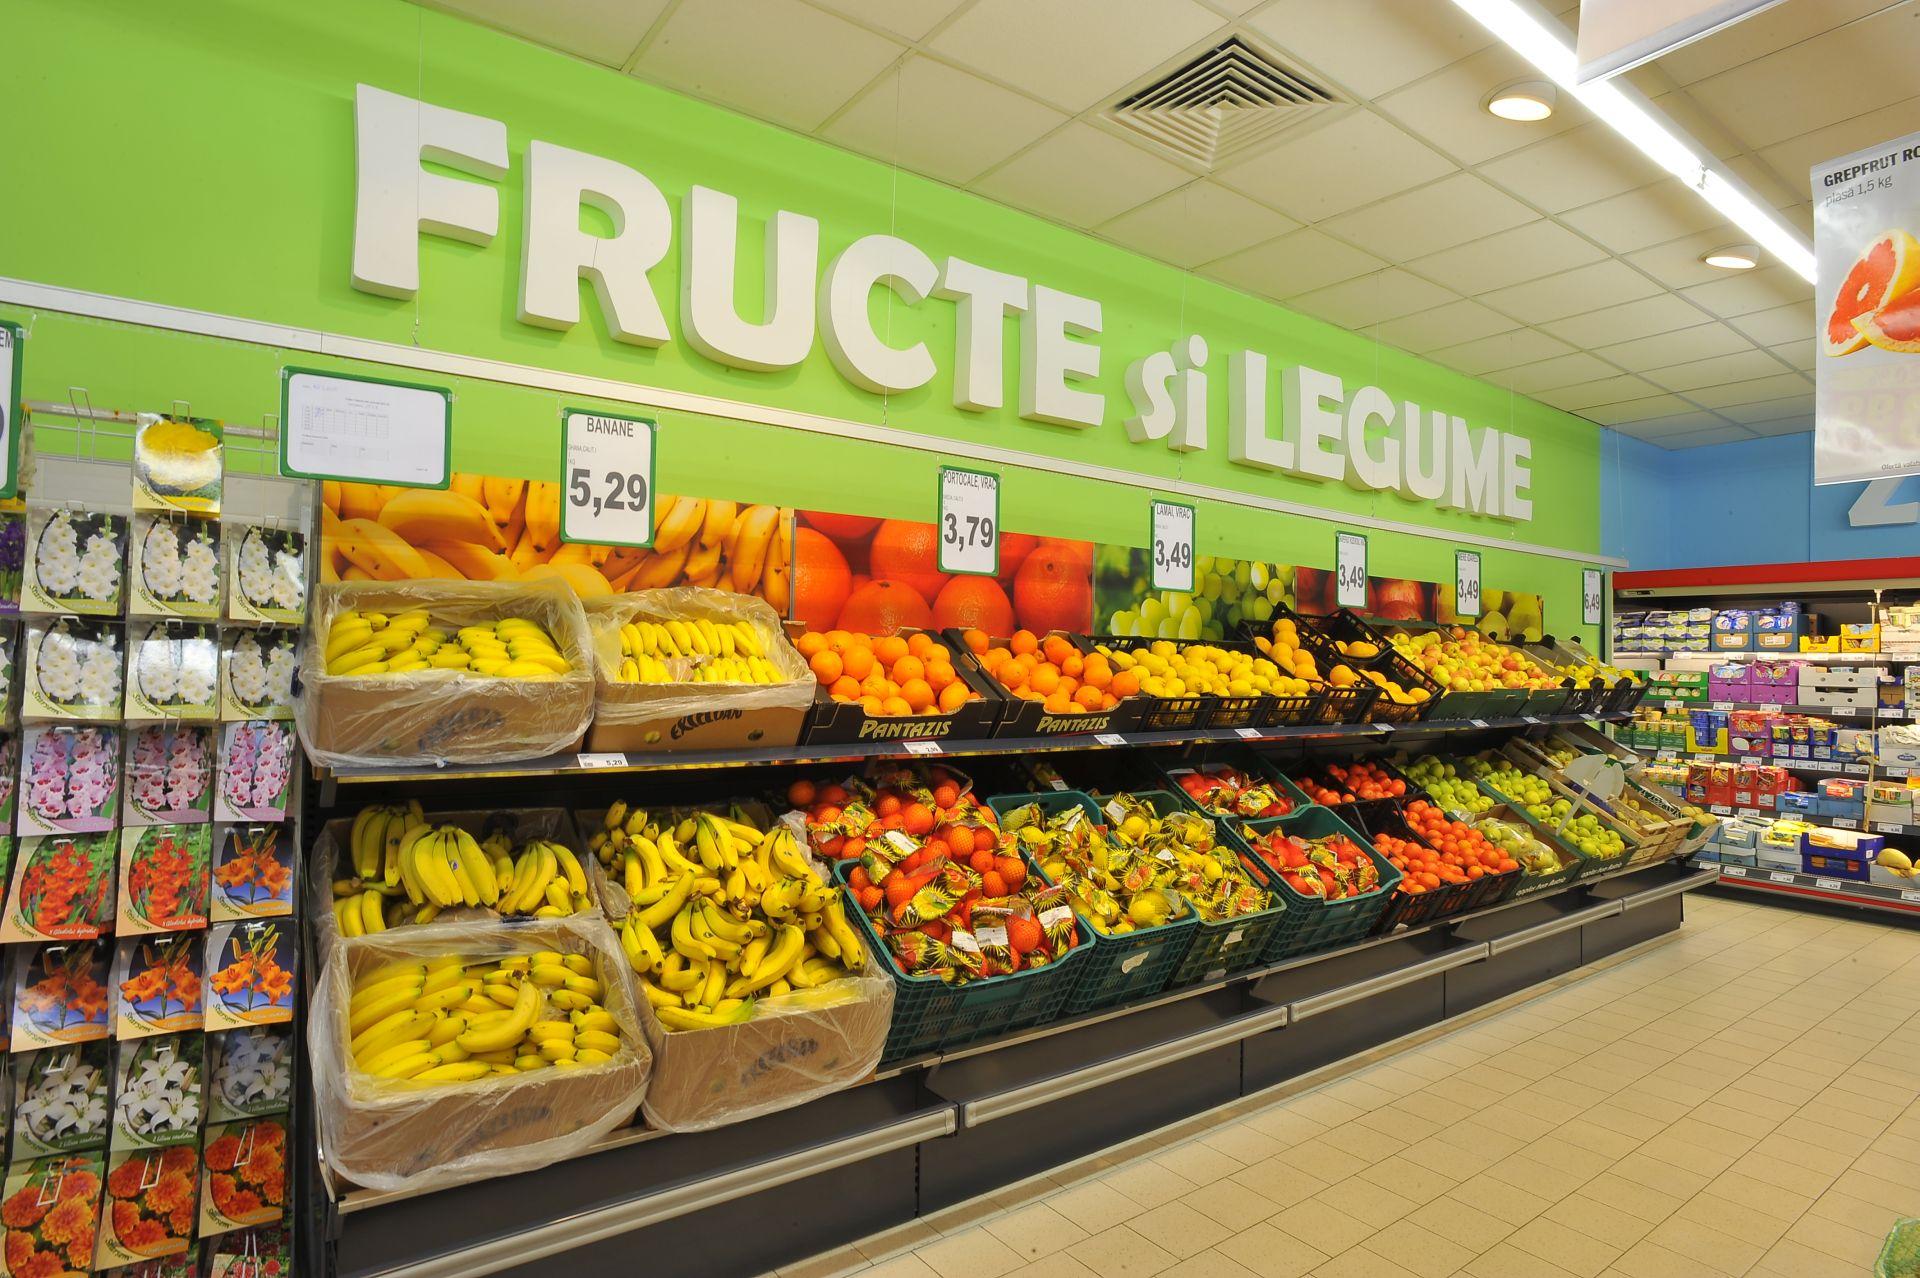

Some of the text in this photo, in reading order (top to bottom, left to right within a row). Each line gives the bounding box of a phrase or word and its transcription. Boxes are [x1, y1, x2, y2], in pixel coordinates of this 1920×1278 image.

[1823, 153, 1898, 187] GREPFRUT
[1857, 179, 1875, 196] 1,5
[1878, 175, 1893, 188] kg
[351, 83, 1105, 429] FRUCTE
[1228, 349, 1532, 522] LEGUME
[586, 417, 634, 437] BANANE
[569, 468, 647, 517] 5,29
[943, 512, 994, 552] 3,79
[1155, 539, 1191, 573] 3,49
[1339, 564, 1365, 592] 3,49
[1458, 578, 1479, 604] 3,49
[1584, 592, 1600, 613] 6,49
[858, 719, 952, 739] PANTAZIS
[1035, 715, 1110, 733] PANTAZIS
